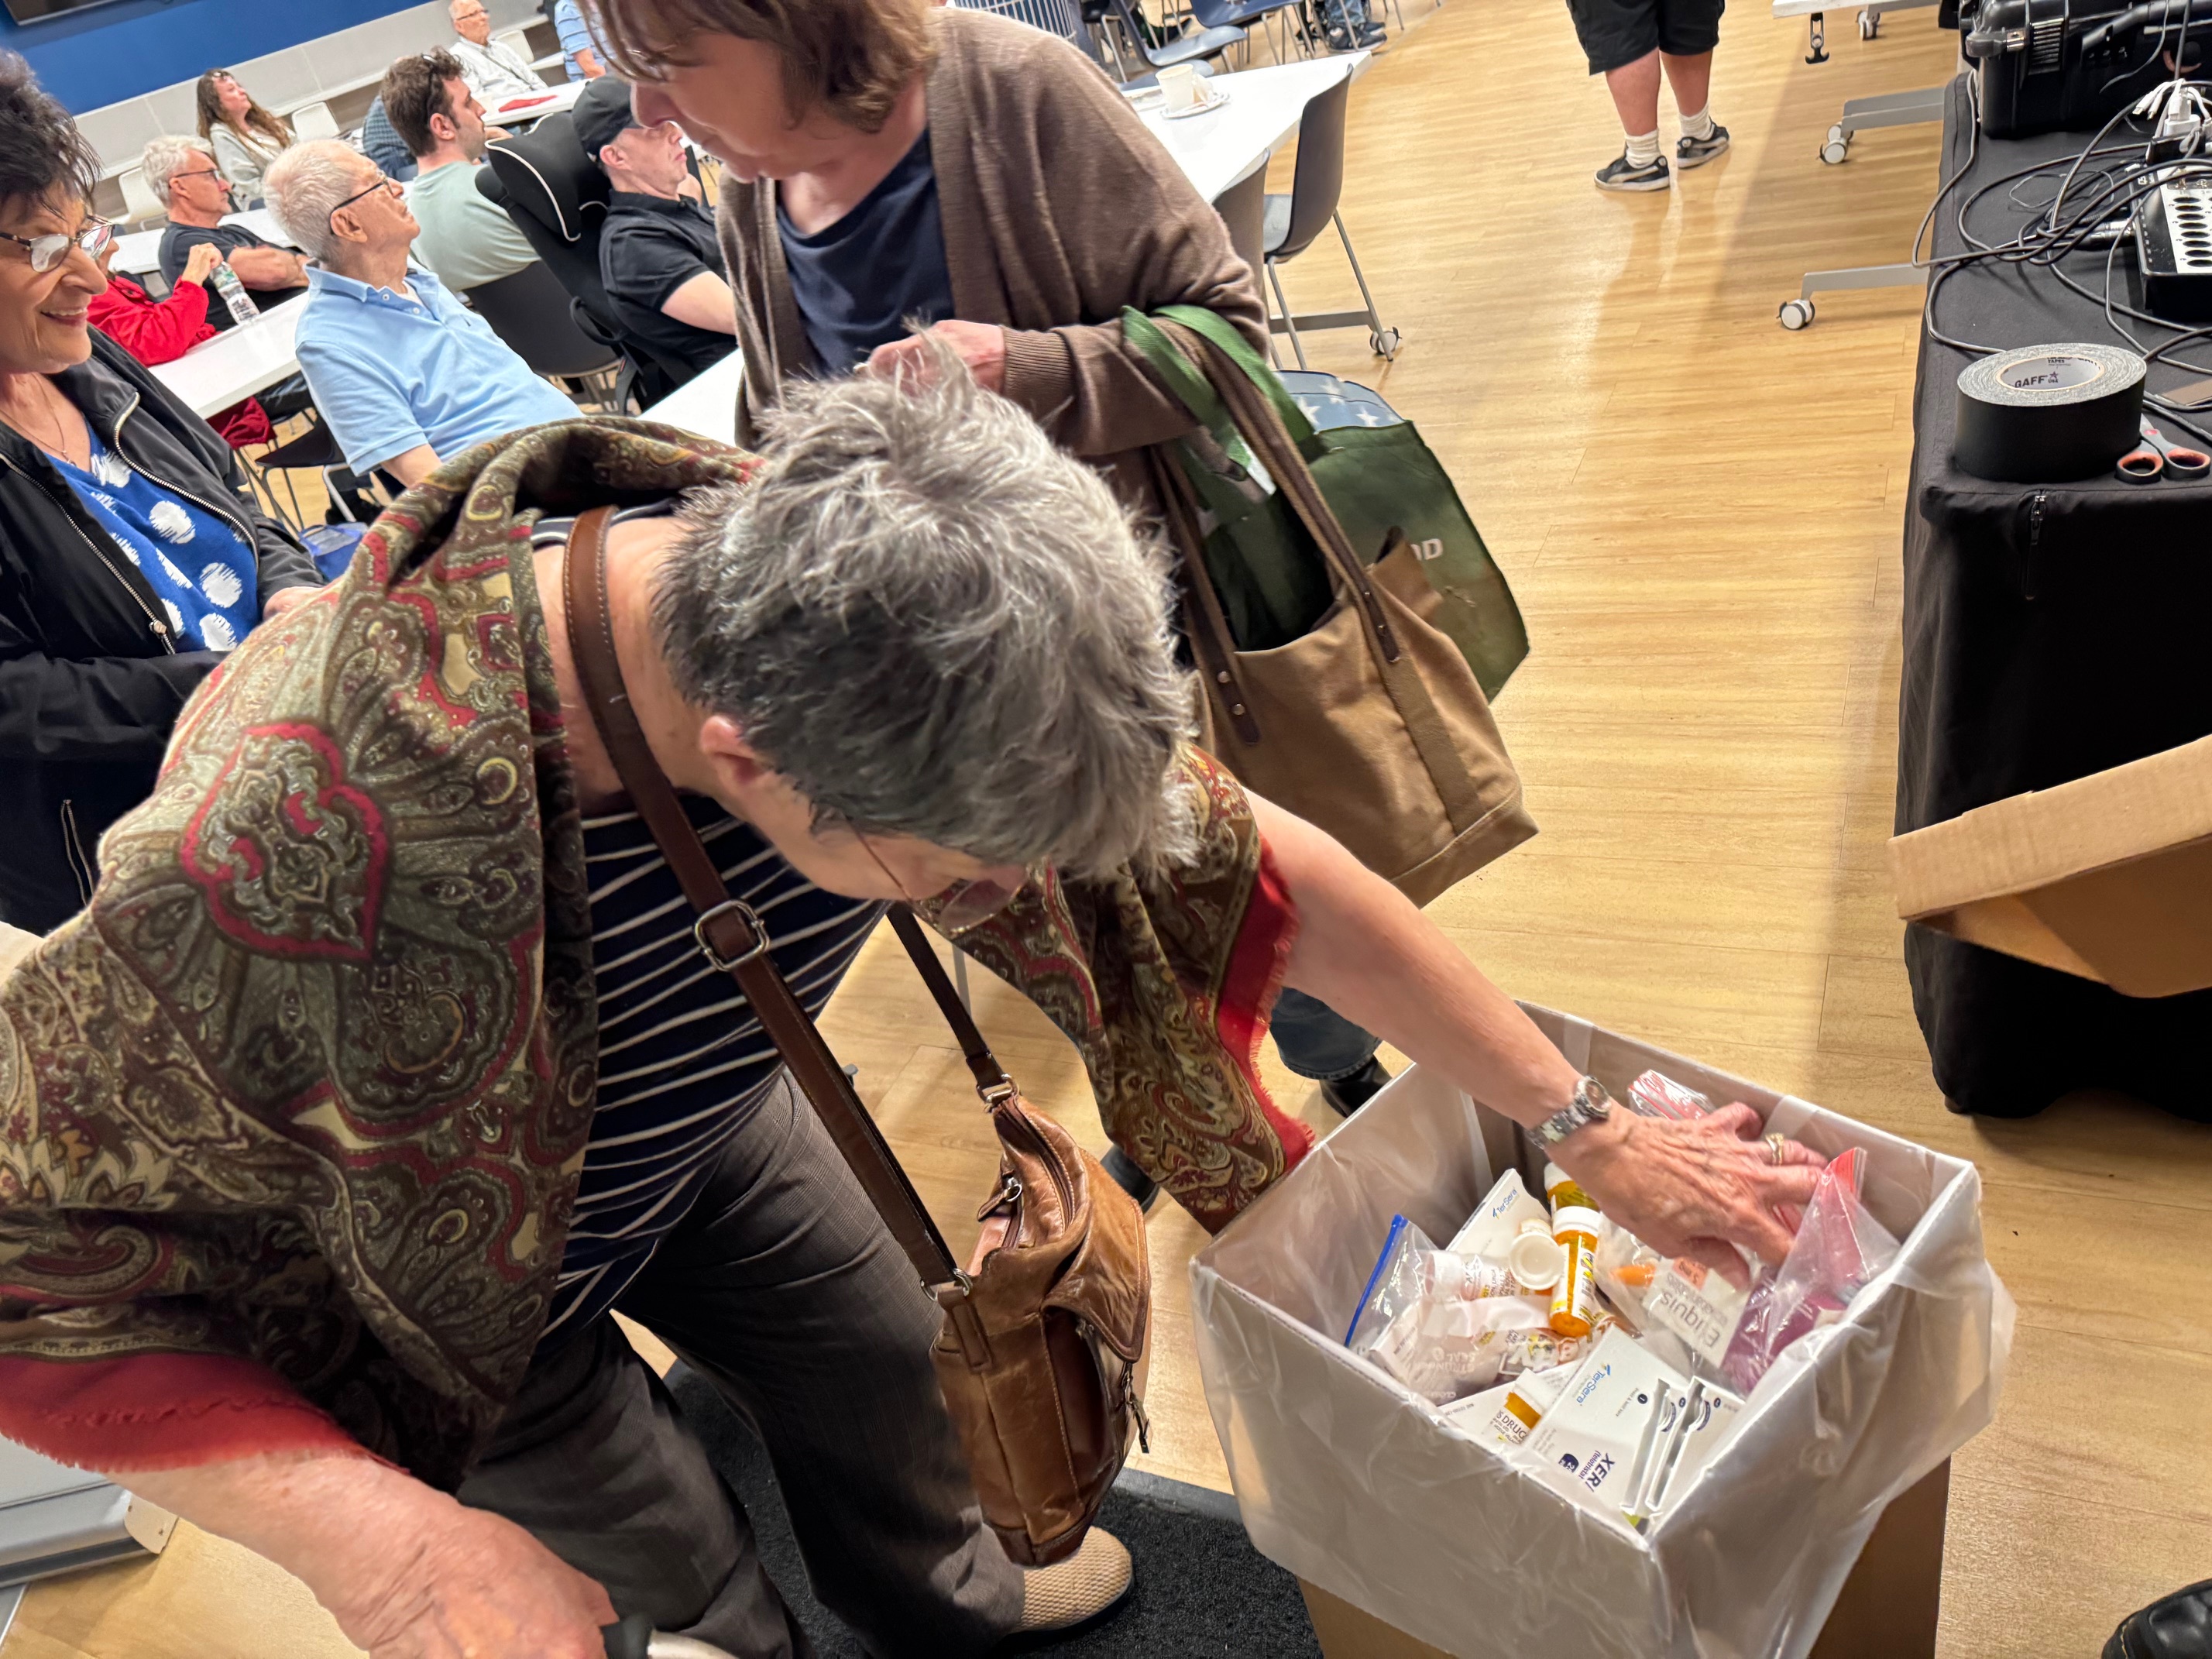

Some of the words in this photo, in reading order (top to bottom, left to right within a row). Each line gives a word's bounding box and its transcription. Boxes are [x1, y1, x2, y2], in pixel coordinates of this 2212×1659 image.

[2015, 375, 2047, 387] GAFF
[1497, 1189, 1518, 1213] TerSera
[1577, 1370, 1605, 1404] TerSera
